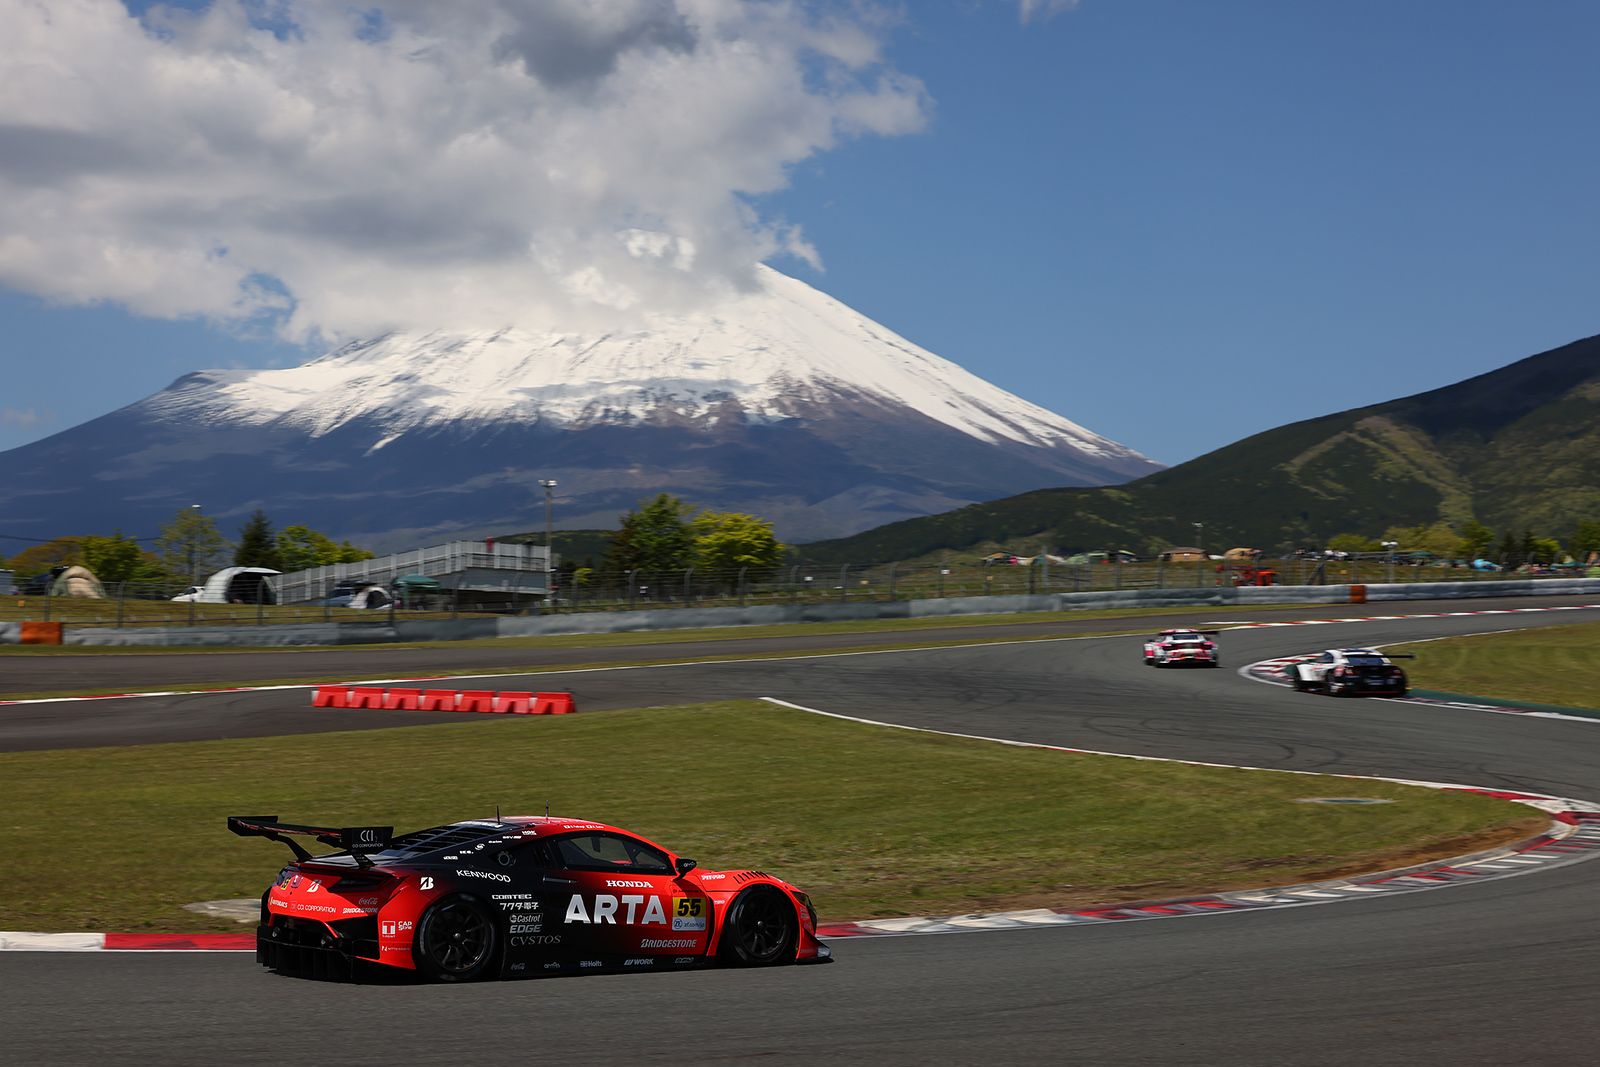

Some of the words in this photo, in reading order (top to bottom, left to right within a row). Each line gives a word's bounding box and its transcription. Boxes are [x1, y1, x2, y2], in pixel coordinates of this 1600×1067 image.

[456, 869, 511, 883] KENWOOD
[606, 880, 654, 889] HONDA
[305, 904, 337, 913] CORPORATION
[563, 894, 667, 925] ARTA
[677, 898, 702, 917] 55
[517, 914, 541, 923] Castrol
[509, 924, 543, 934] EDGE
[510, 935, 562, 947] CVSTOS
[640, 939, 697, 948] BRIDGESTONE
[633, 958, 654, 966] WORK
